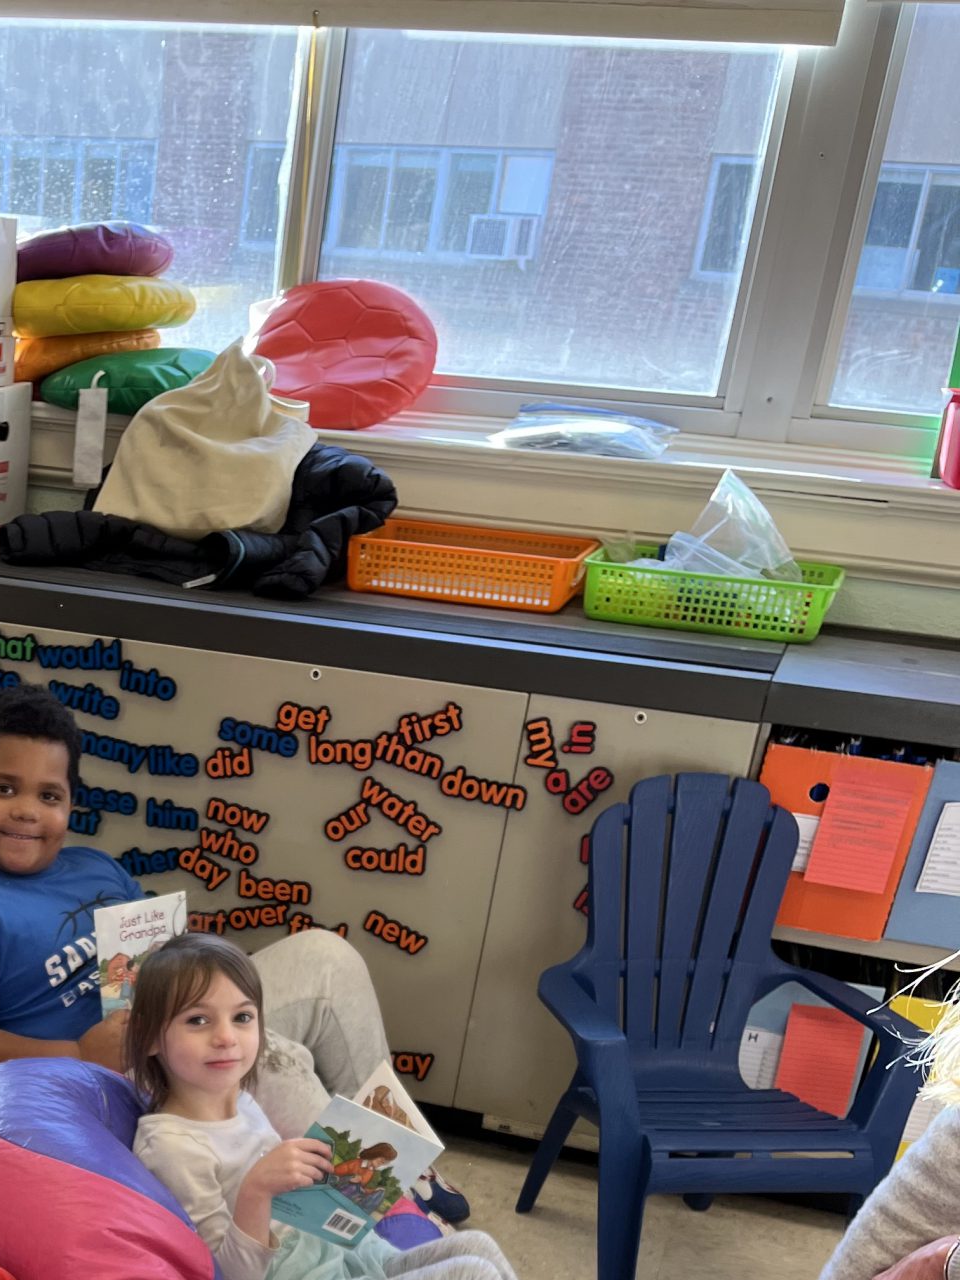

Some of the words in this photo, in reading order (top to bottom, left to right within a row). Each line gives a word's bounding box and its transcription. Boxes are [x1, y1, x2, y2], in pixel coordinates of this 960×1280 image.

[37, 638, 122, 670] would
[119, 659, 176, 701] into
[48, 680, 120, 720] write
[275, 701, 331, 735] get
[398, 702, 462, 747] first
[218, 717, 298, 758] some
[308, 734, 373, 771] long
[374, 731, 443, 779] than
[524, 717, 558, 770] my
[561, 721, 596, 754] in
[146, 744, 200, 777] like
[205, 747, 254, 779] did
[441, 766, 527, 811] down
[545, 768, 569, 795] a
[562, 766, 615, 815] are
[74, 783, 138, 816] hese
[146, 797, 198, 832] him
[206, 797, 269, 833] now
[361, 776, 442, 843] water
[69, 810, 101, 836] ut
[324, 802, 370, 841] our
[117, 847, 179, 878] ther
[200, 827, 259, 866] who
[345, 843, 427, 875] could
[178, 847, 230, 890] day
[238, 869, 311, 904] been
[119, 913, 142, 930] Just
[144, 909, 166, 924] Like
[119, 923, 168, 943] Grandpa
[186, 911, 227, 935] art
[228, 902, 290, 930] over
[364, 909, 428, 955] new
[390, 1051, 434, 1081] ay
